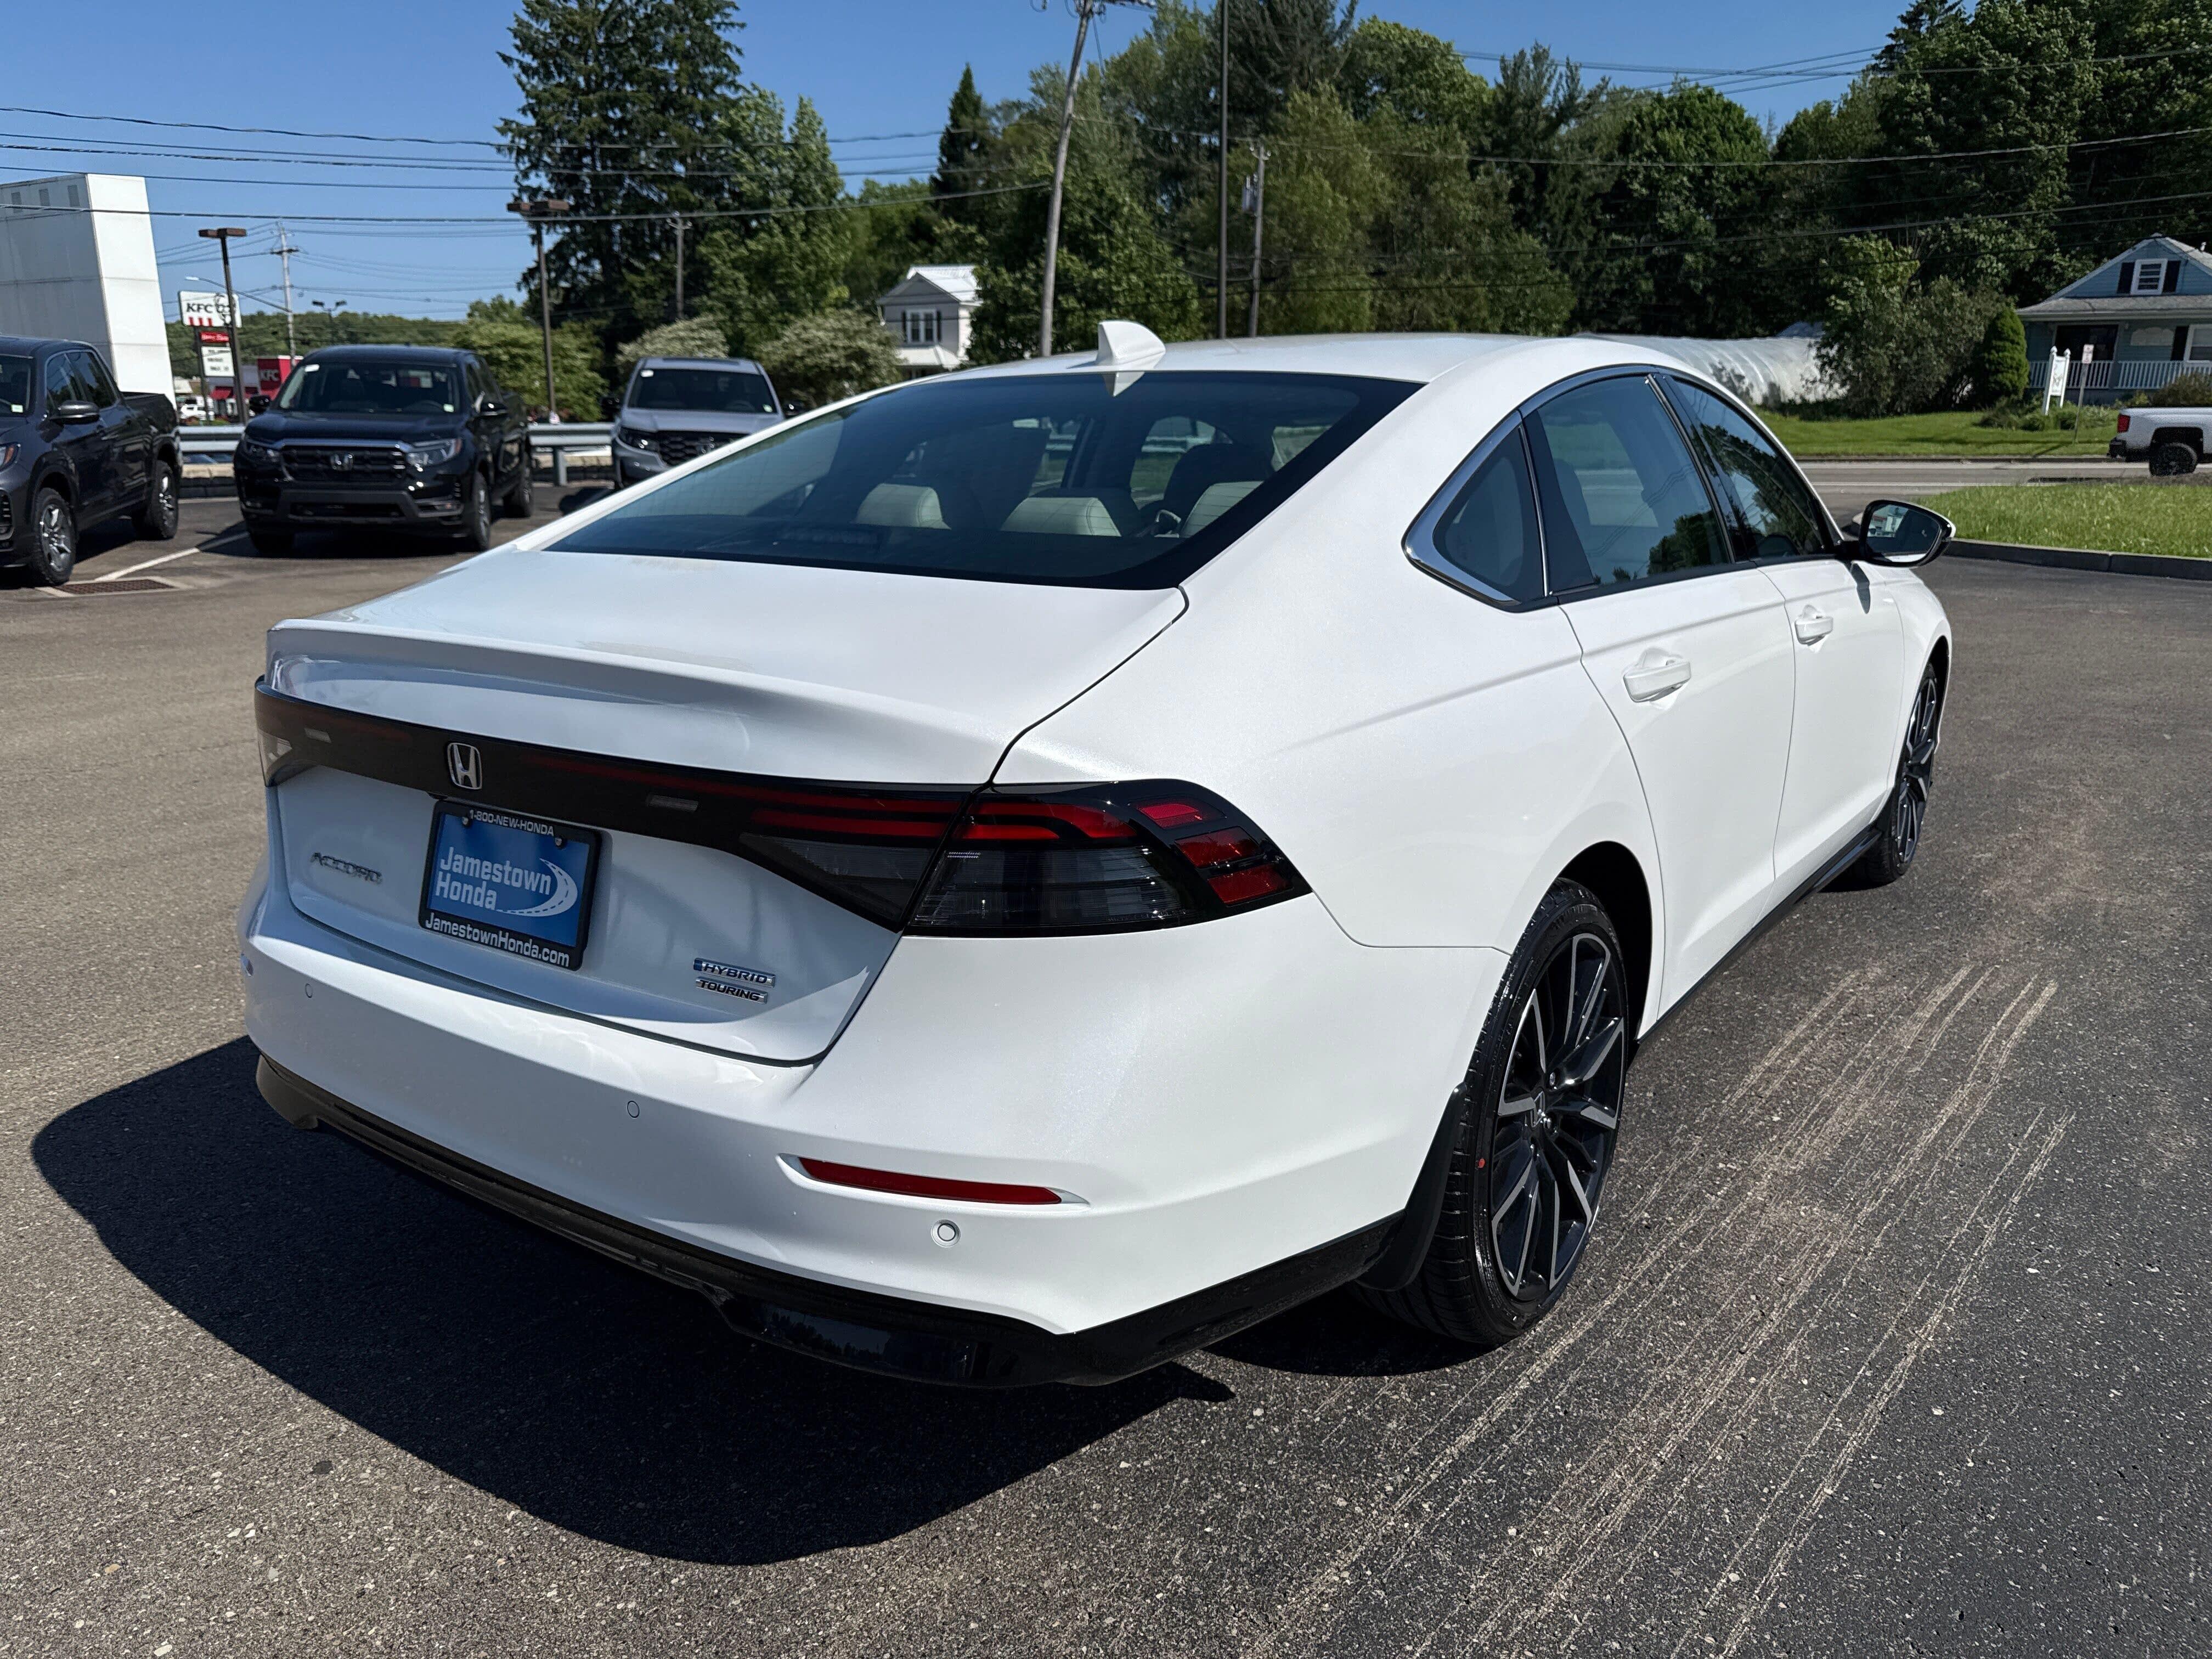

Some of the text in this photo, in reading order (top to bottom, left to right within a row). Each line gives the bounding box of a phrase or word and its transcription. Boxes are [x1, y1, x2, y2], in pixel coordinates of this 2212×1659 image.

[187, 303, 213, 313] KFC
[259, 369, 280, 381] KFC
[469, 809, 554, 837] 1-800-NEW-HONDA
[309, 852, 383, 885] ACCORD
[440, 847, 551, 895] Jamestown
[435, 871, 498, 911] Honda
[425, 912, 570, 967] JamestownHonda.com
[704, 963, 768, 984] HYBRID
[699, 979, 761, 1001] TOURING
